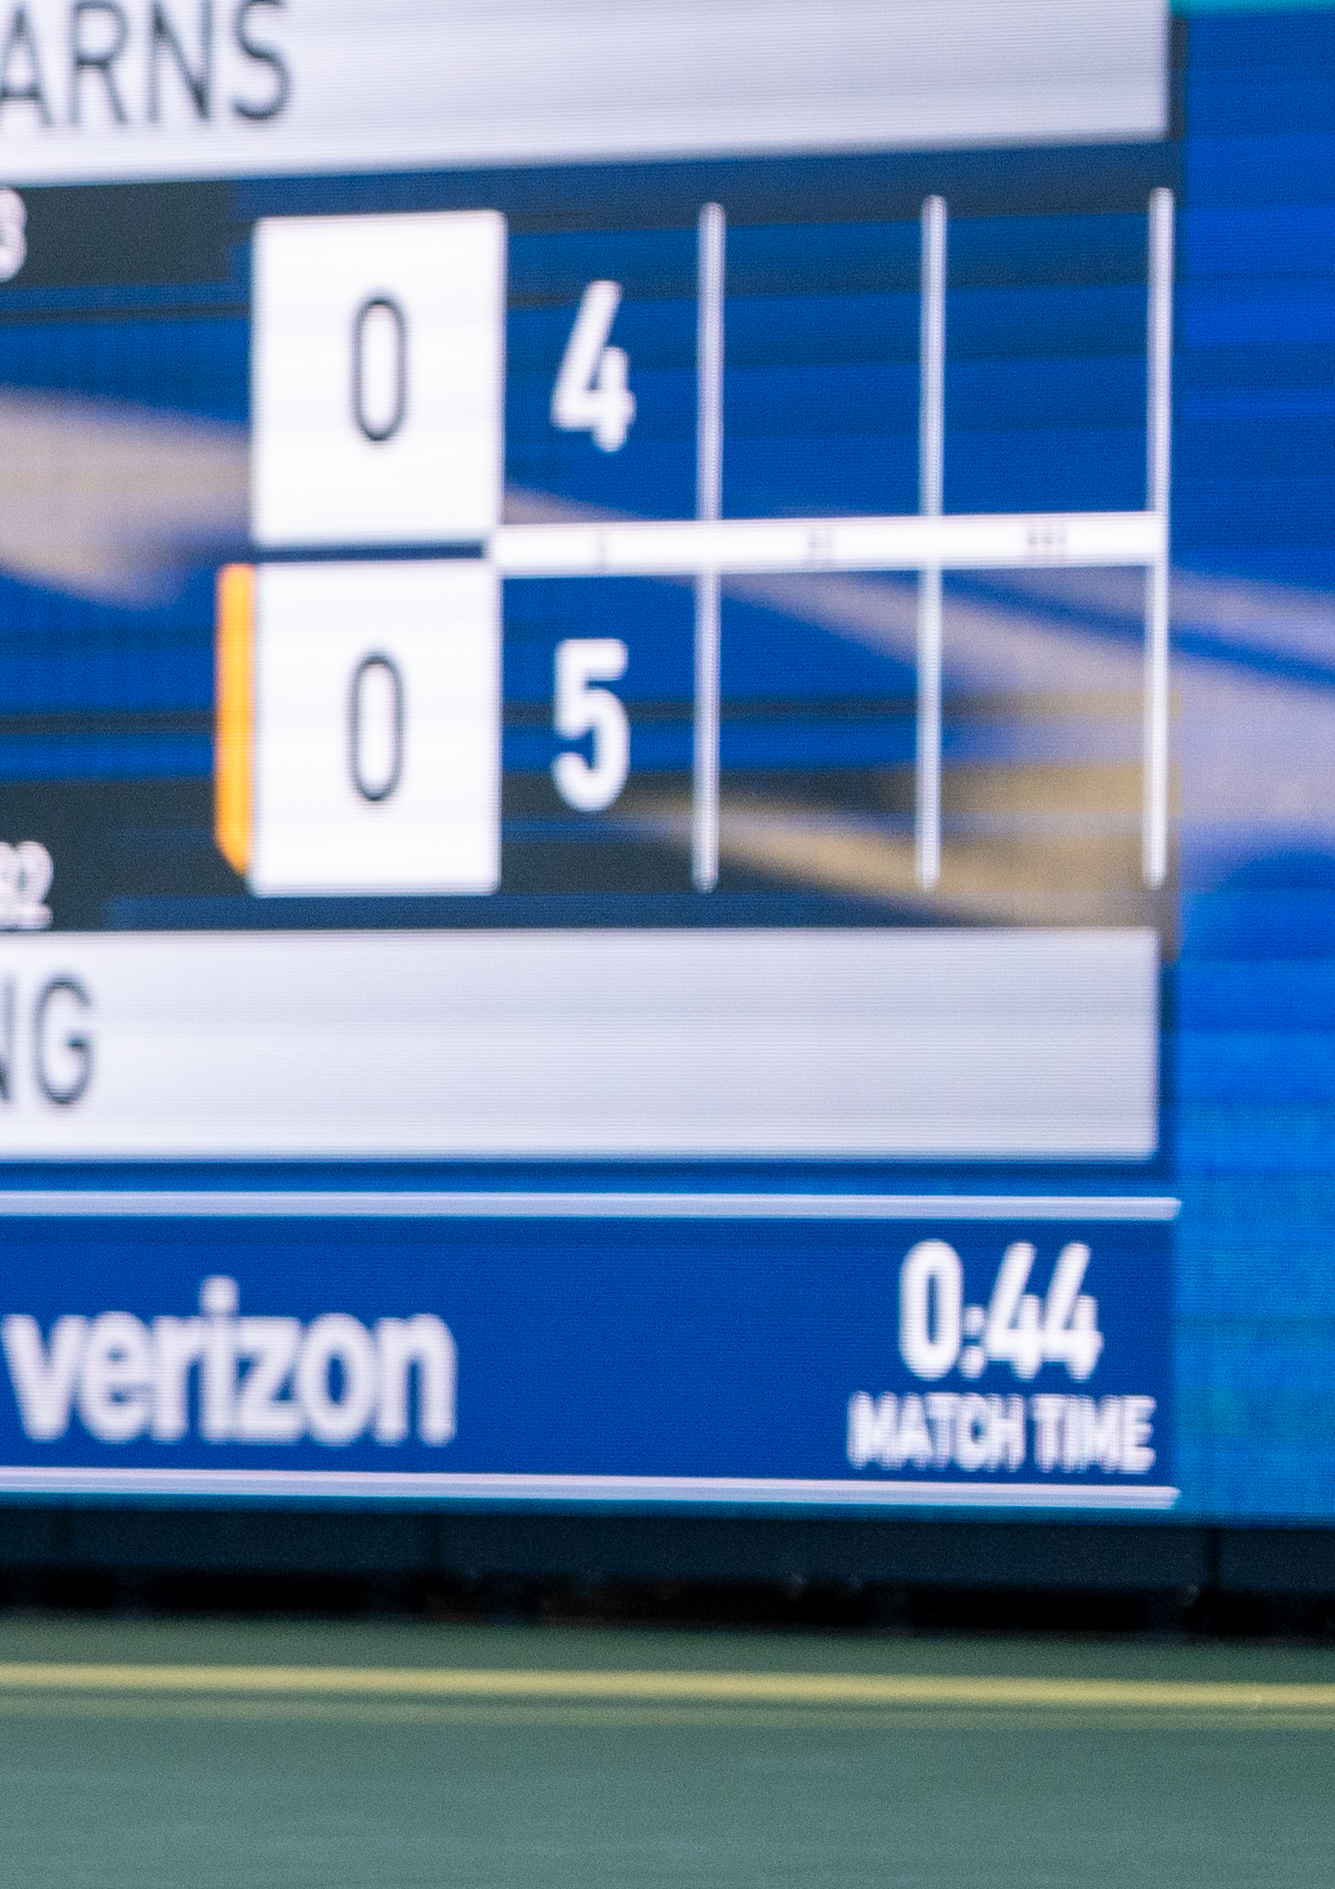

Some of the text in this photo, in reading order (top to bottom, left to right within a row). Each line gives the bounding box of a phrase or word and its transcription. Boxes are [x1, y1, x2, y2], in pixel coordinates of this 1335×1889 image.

[351, 280, 635, 451] 0 4
[347, 638, 630, 811] 0 5
[1, 1276, 457, 1443] verizon
[900, 1239, 1104, 1381] 0:44
[847, 1391, 1157, 1474] MATCH TIME
